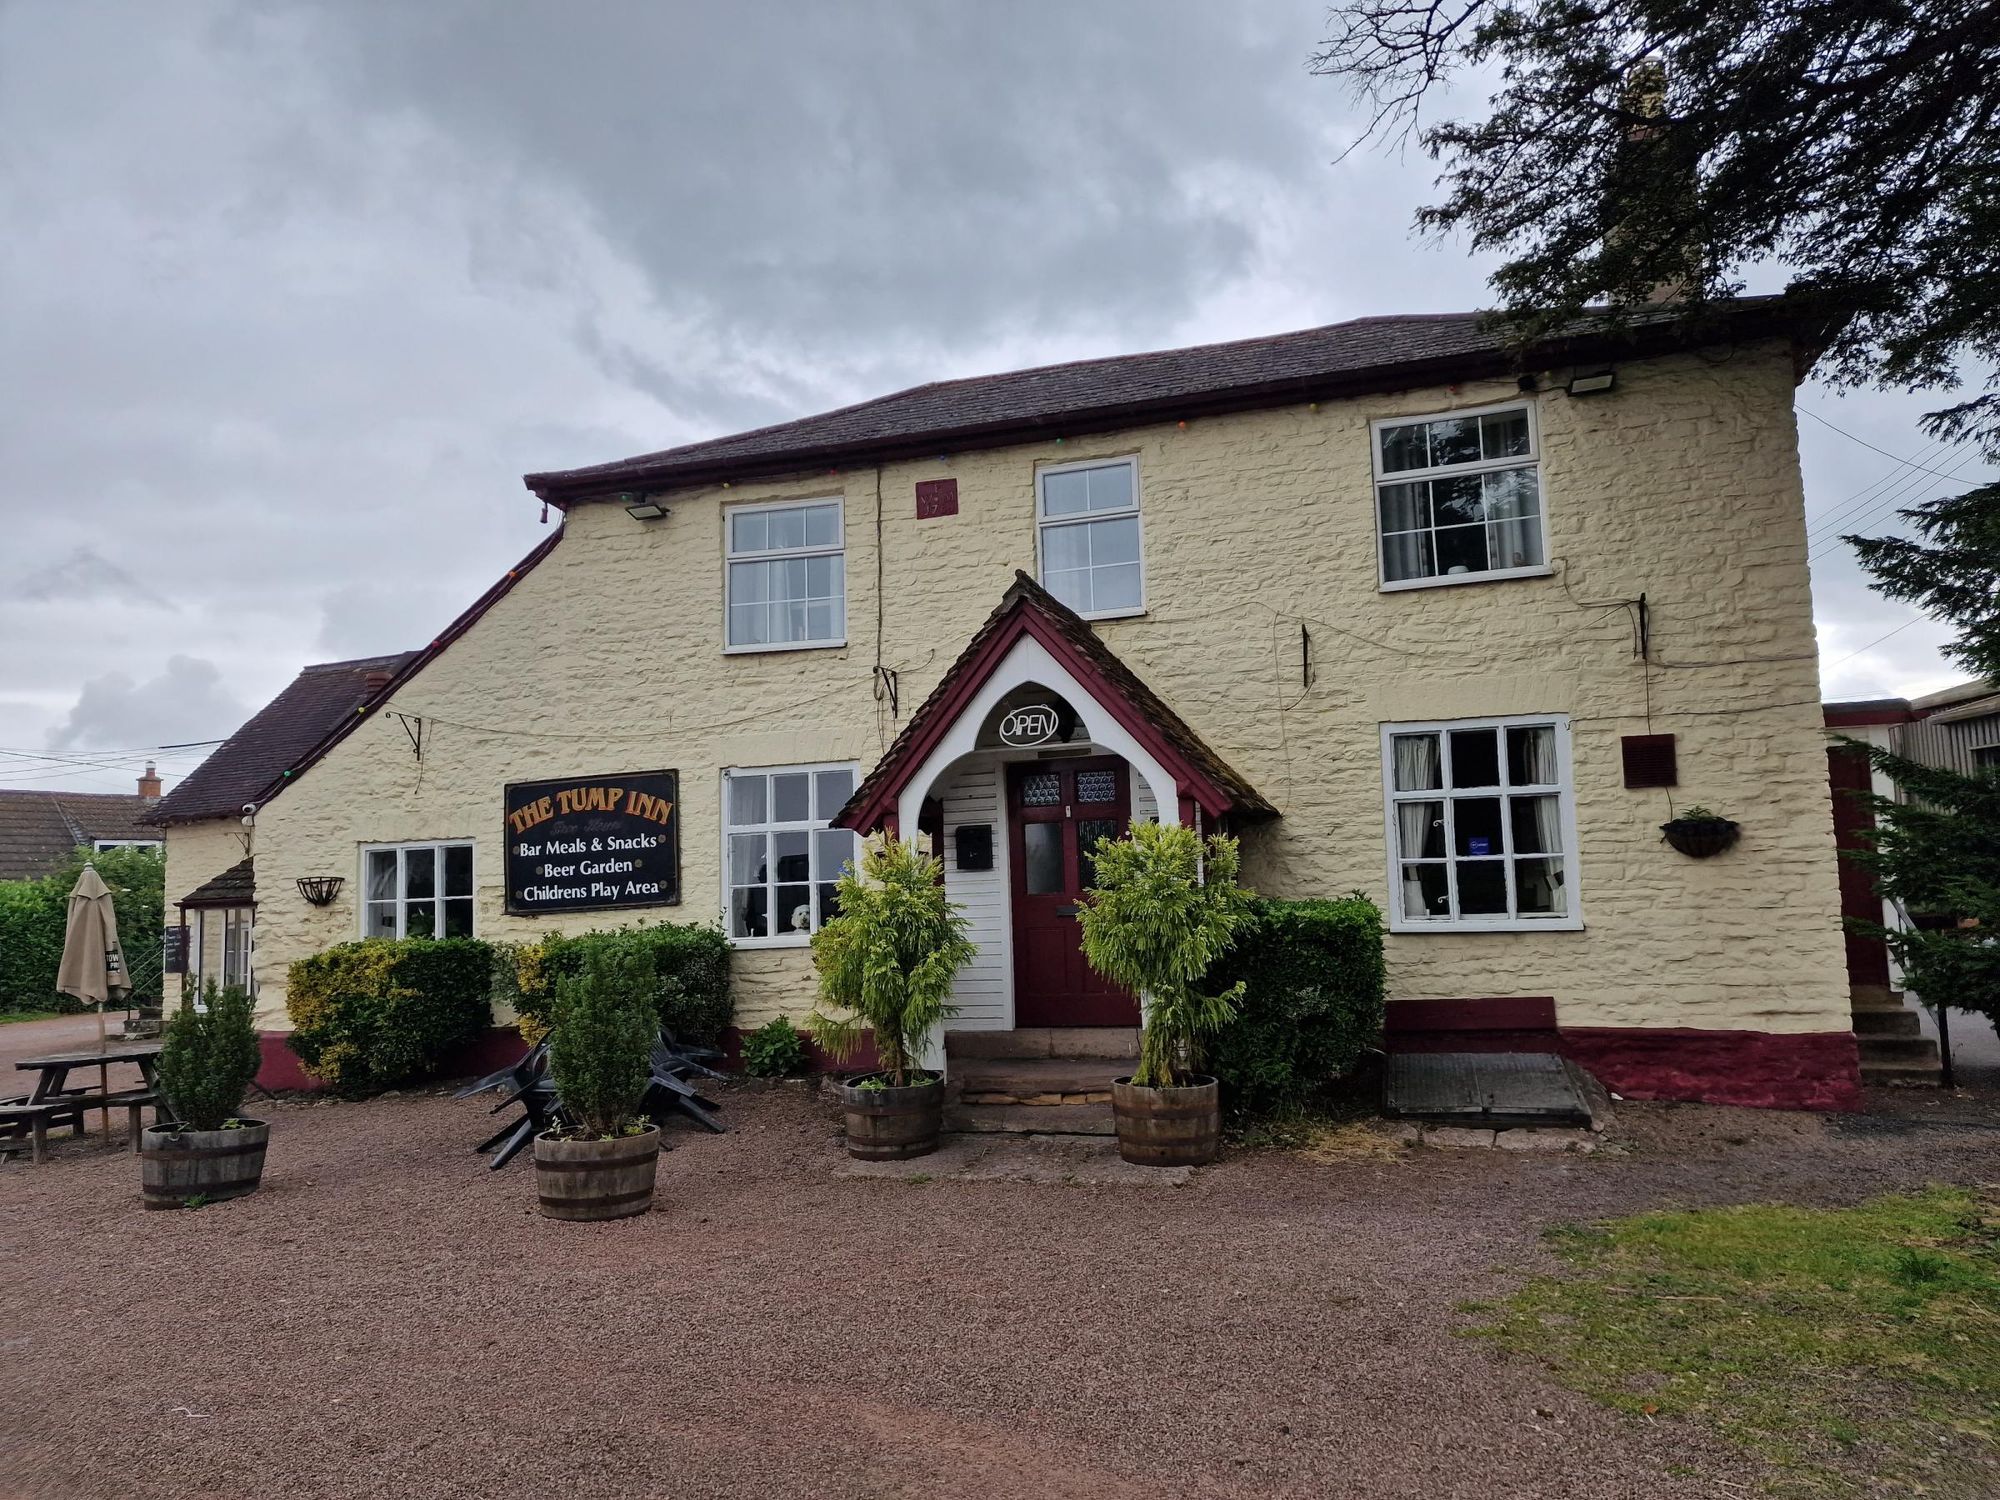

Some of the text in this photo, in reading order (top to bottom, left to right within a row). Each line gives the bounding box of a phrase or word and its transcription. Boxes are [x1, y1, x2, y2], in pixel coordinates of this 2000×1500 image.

[1001, 714, 1055, 736] OPEN
[509, 796, 554, 834] THE
[556, 787, 624, 814] TUMP
[625, 791, 673, 825] INN
[520, 833, 657, 857] Bar Meals & Snacks
[544, 858, 632, 878] Beer Garden
[523, 881, 659, 901] Childrens Play Area
